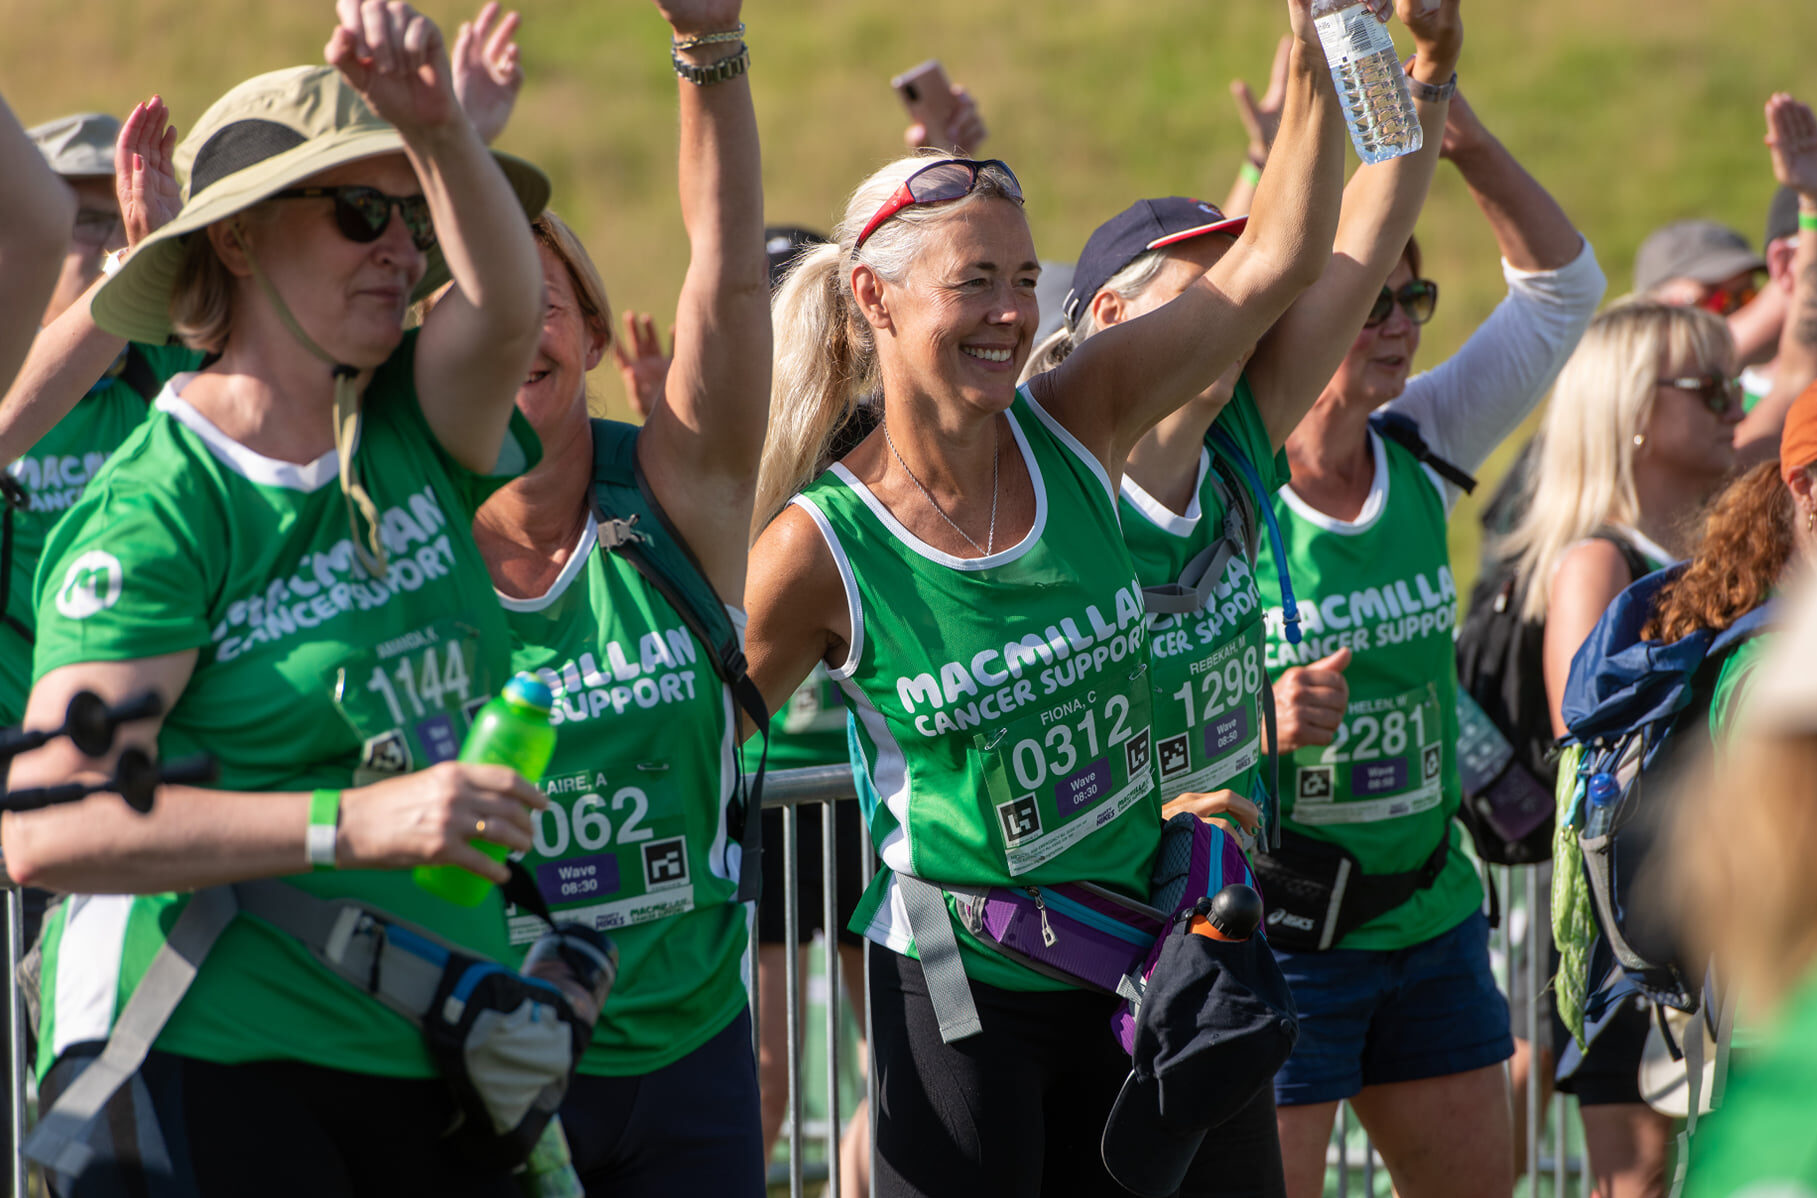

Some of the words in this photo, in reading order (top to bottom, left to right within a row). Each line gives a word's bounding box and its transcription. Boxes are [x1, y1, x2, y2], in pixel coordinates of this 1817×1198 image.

[1190, 643, 1238, 675] REBEKAH,
[1265, 627, 1370, 668] CANCER
[367, 639, 469, 724] 1144
[915, 679, 1036, 737] CANCER
[1040, 617, 1146, 694] SUPPORT
[1173, 645, 1259, 728] 1298
[548, 670, 695, 725] SUPPORT
[1040, 697, 1086, 726] FIONA,
[1088, 690, 1097, 703] C
[1012, 694, 1132, 790] 0312
[1216, 719, 1237, 735] Wave
[1320, 703, 1425, 764] 2281
[595, 772, 608, 787] A
[1070, 772, 1096, 791] Wave
[1073, 784, 1098, 805] 08:30
[511, 786, 654, 861] 062
[558, 864, 597, 880] Wave
[561, 878, 598, 896] 08:30
